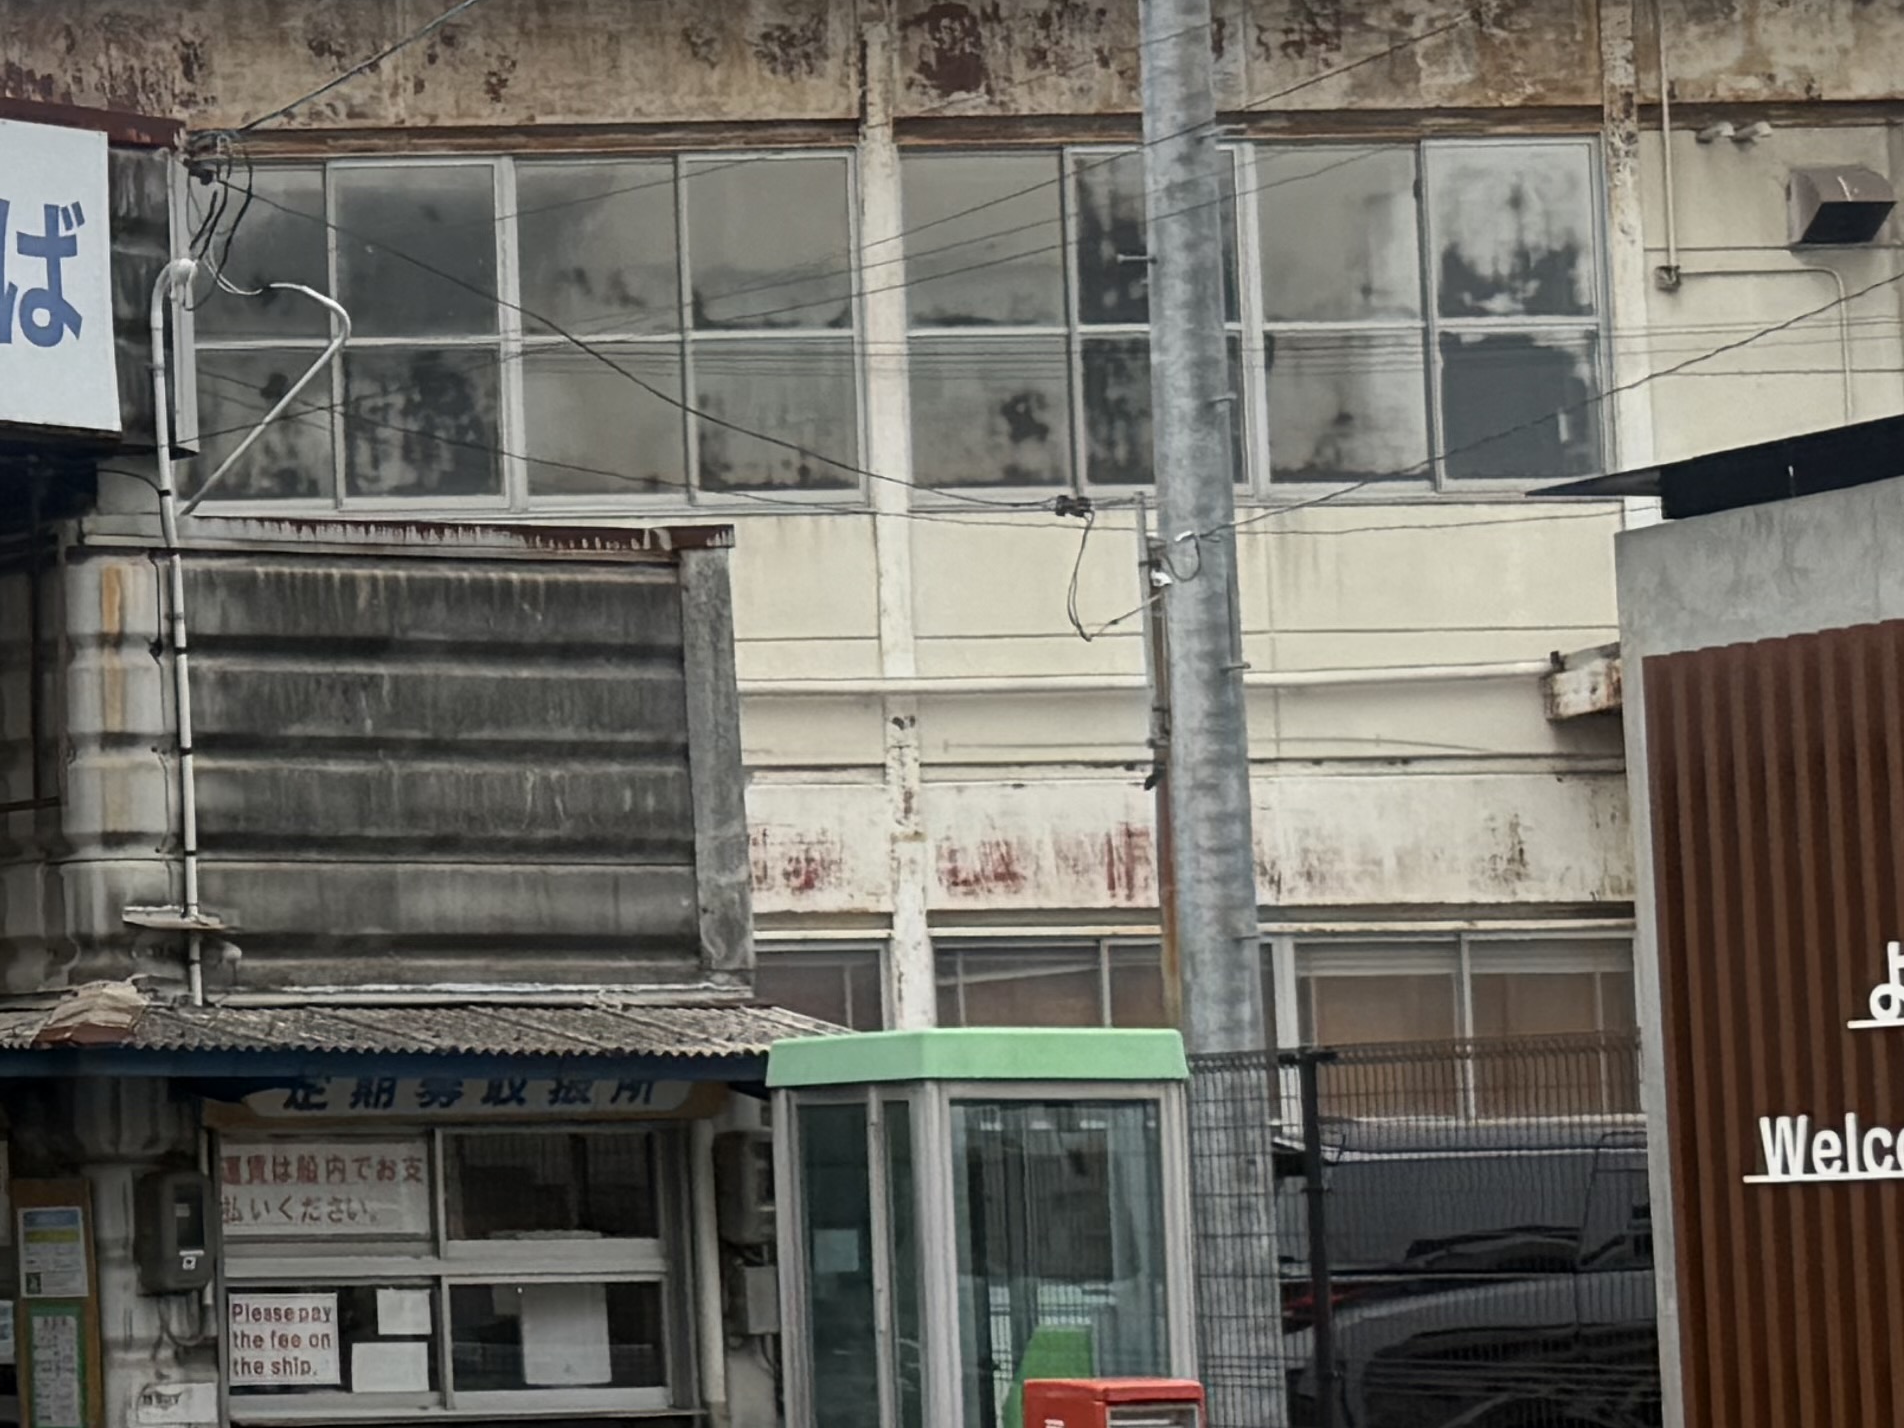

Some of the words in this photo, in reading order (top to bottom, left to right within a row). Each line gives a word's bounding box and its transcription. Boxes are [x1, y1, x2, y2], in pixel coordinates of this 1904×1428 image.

[1758, 1111, 1904, 1178] Welc
[232, 1303, 296, 1323] Please
[298, 1306, 333, 1324] pay
[232, 1330, 264, 1349] the
[270, 1330, 301, 1348] fee
[308, 1331, 332, 1348] on
[232, 1357, 264, 1377] the
